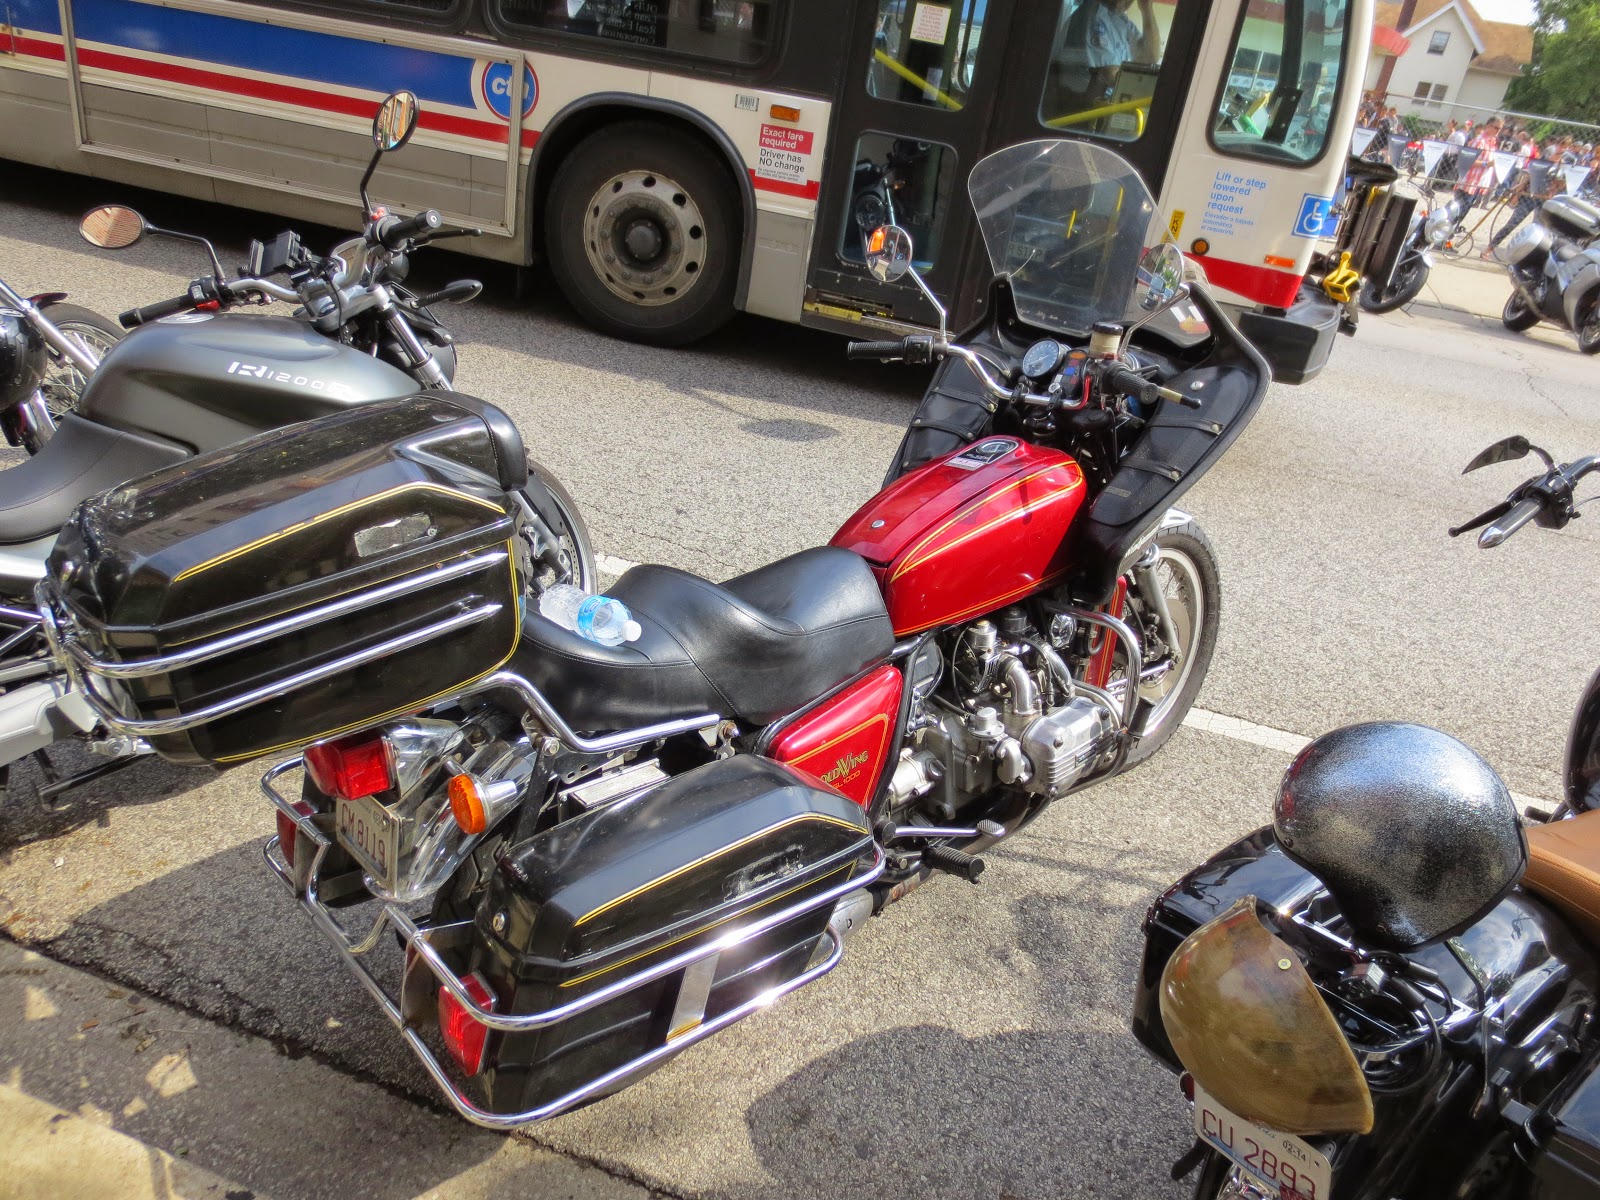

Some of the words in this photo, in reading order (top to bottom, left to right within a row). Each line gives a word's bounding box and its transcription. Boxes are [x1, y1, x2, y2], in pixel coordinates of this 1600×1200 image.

[762, 126, 786, 139] Exact
[787, 131, 804, 142] fare
[761, 136, 797, 149] required
[760, 148, 785, 160] Driver
[786, 153, 802, 163] has
[759, 157, 773, 167] NO
[774, 160, 805, 174] change
[1212, 181, 1251, 196] lowered
[1215, 171, 1232, 182] Lift
[1233, 176, 1244, 184] or
[1245, 178, 1267, 190] step
[1210, 192, 1234, 203] upon
[1207, 201, 1244, 214] request
[341, 803, 355, 836] CM
[357, 819, 387, 870] 8119
[1202, 1108, 1234, 1149] CU
[1243, 1137, 1316, 1200] 2893
[1282, 1140, 1307, 1162] 02-14
